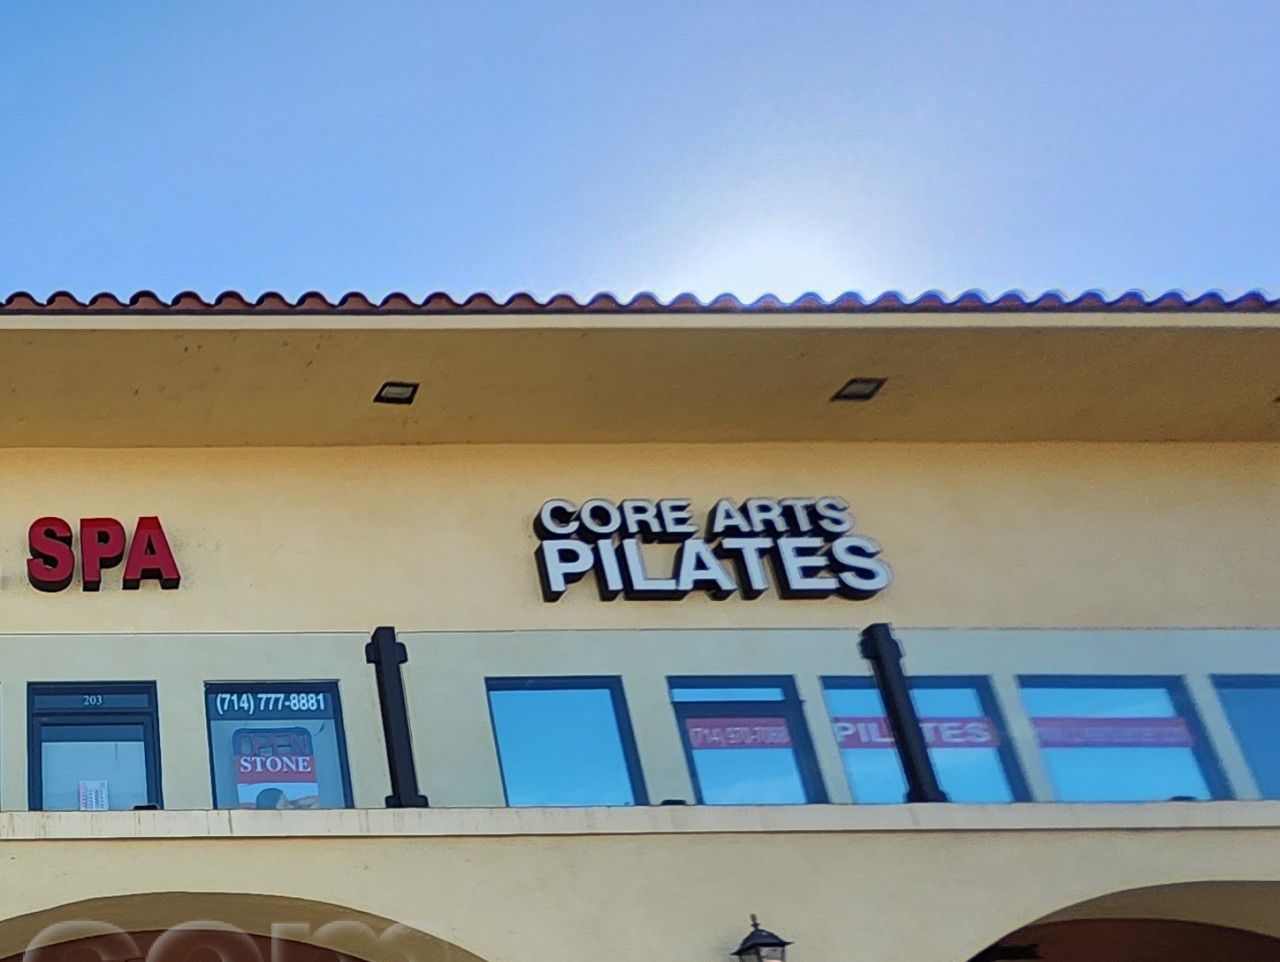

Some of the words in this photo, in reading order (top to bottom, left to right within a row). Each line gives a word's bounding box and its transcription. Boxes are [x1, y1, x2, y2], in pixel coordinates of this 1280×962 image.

[533, 497, 701, 543] CORE
[709, 496, 856, 537] ARTS
[27, 516, 181, 592] SPA
[535, 535, 893, 602] PILATES
[83, 695, 103, 706] 203
[216, 692, 255, 715] (714)
[257, 692, 325, 711] 777-8881
[832, 722, 992, 743] PILTES
[239, 756, 312, 773] STONE
